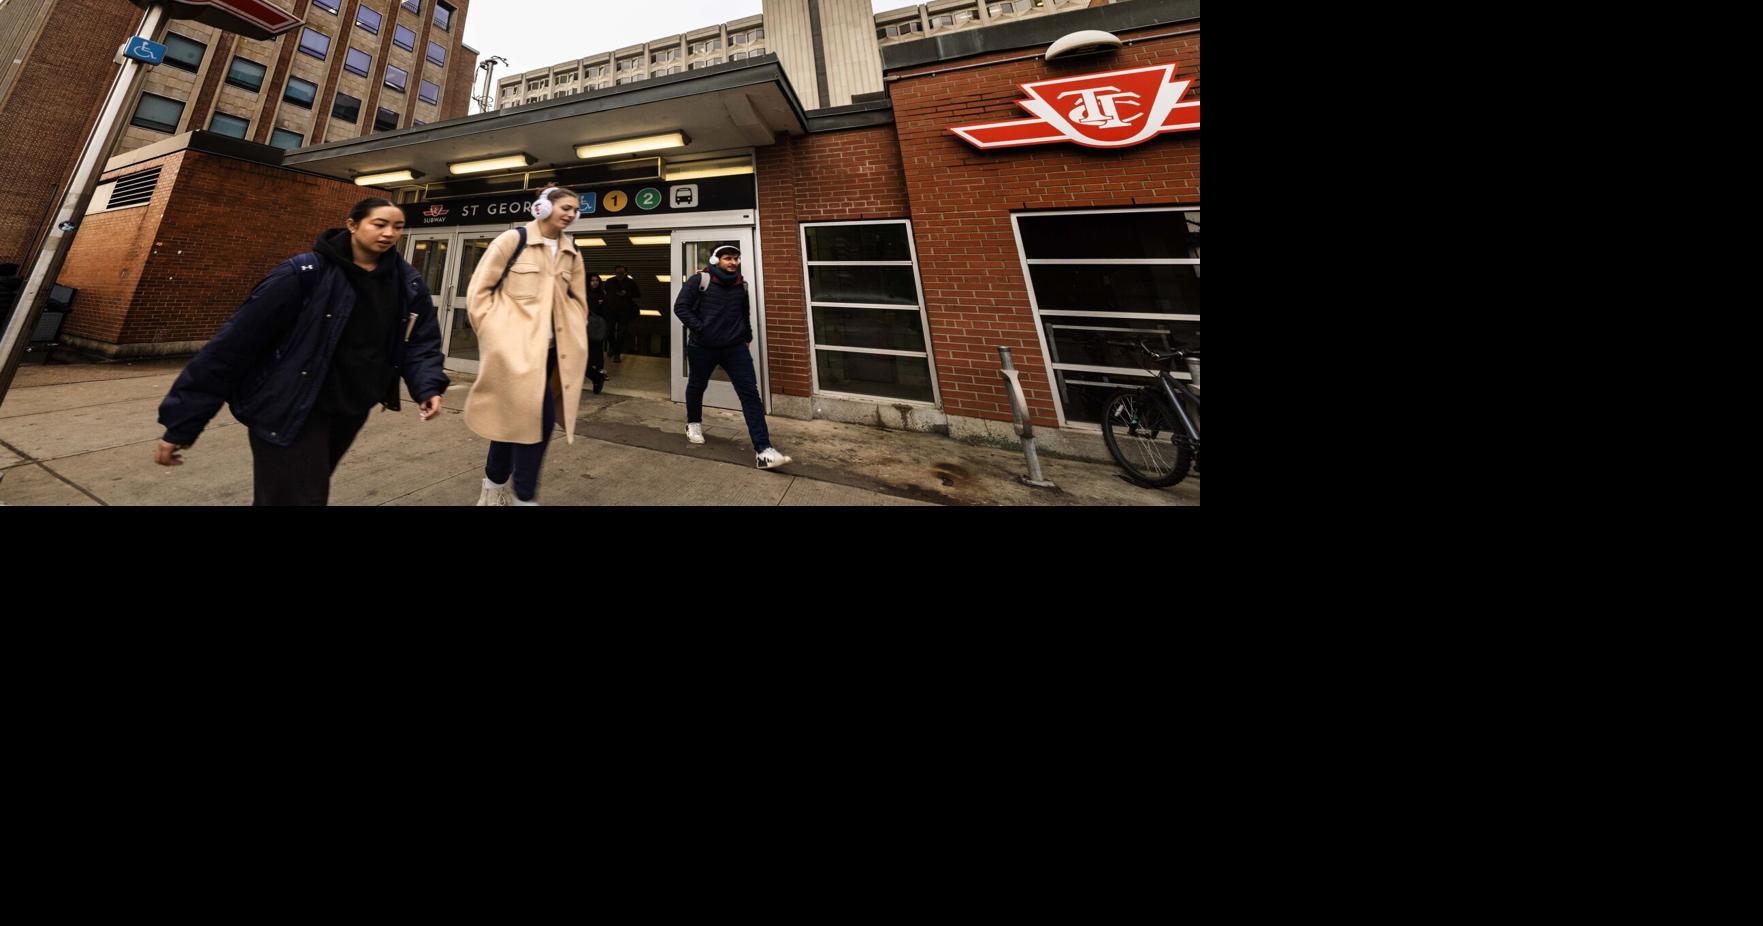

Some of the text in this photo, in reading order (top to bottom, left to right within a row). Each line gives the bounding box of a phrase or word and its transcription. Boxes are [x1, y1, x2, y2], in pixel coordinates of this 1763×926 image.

[611, 195, 618, 207] 1
[643, 192, 654, 205] 2
[462, 201, 531, 217] ST GEOR
